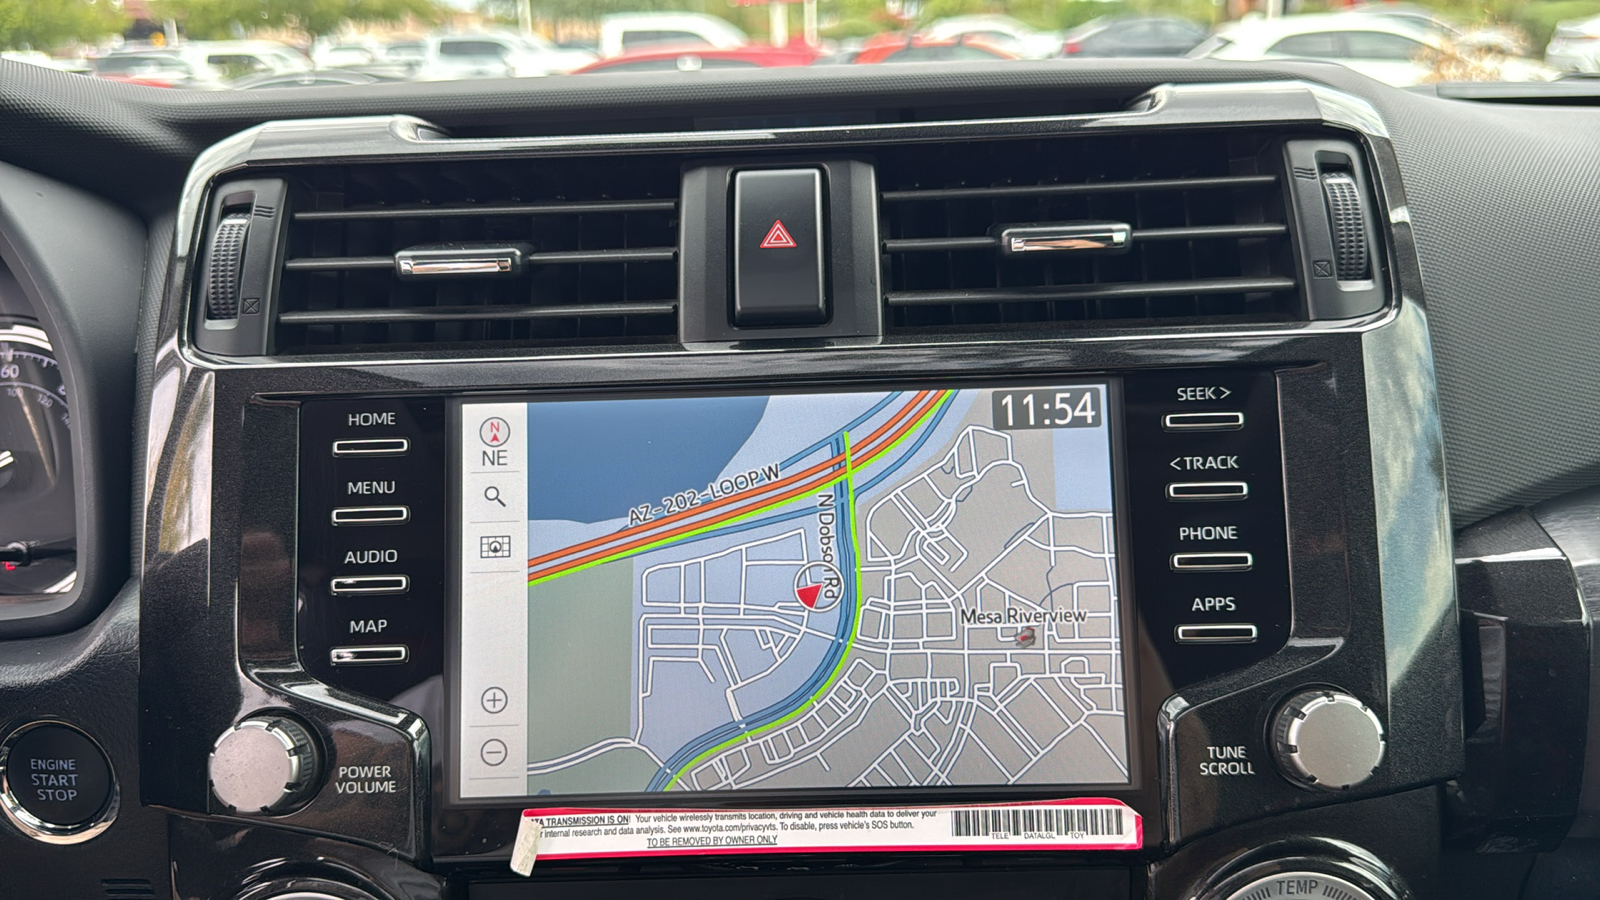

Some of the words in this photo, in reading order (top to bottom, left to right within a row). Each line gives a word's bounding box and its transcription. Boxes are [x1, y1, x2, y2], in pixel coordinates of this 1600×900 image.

[0, 364, 20, 379] 60
[1000, 393, 1097, 426] 11:54
[348, 412, 397, 426] HOME
[490, 421, 501, 433] N
[482, 450, 508, 466] NE
[347, 481, 397, 495] MENU
[628, 470, 759, 526] AZ-202-LOOP
[761, 463, 780, 482] W
[818, 494, 834, 508] N
[1179, 526, 1239, 541] PHONE
[818, 513, 836, 573] Dobson
[344, 550, 398, 565] AUDIO
[823, 577, 841, 600] Rd
[1191, 597, 1237, 612] APPS
[961, 608, 1002, 624] Mesa
[1006, 607, 1088, 624] Riverview
[349, 619, 388, 634] MAP
[1206, 746, 1246, 760] TUNE
[30, 758, 76, 772] ENGINE
[338, 765, 391, 779] POWER
[1199, 761, 1256, 776] SCROLL
[30, 774, 79, 788] START
[334, 780, 397, 795] VOLUME
[37, 788, 78, 803] STOP
[546, 816, 604, 827] TRANSMISSION
[607, 815, 615, 824] IS
[635, 814, 651, 823] Your
[653, 812, 677, 823] vehicle
[679, 813, 714, 823] wirelessly
[715, 812, 746, 821] transmits
[748, 812, 778, 821] location,
[779, 811, 803, 821] driving
[804, 811, 818, 819] and
[820, 811, 844, 819] vehicle
[846, 810, 868, 818] health
[869, 810, 886, 818] data
[887, 810, 895, 818] to
[896, 810, 919, 818] deliver
[921, 810, 937, 820] your
[544, 828, 571, 838] internal
[572, 827, 603, 837] research
[604, 827, 617, 836] and
[619, 827, 635, 835] data
[636, 825, 666, 836] analysis.
[667, 824, 682, 834] See
[779, 822, 789, 831] To
[790, 821, 818, 831] disable,
[819, 822, 839, 832] press
[840, 820, 870, 829] vehicle's
[872, 820, 888, 829] SOS
[890, 821, 914, 829] button.
[991, 832, 1009, 840] TELE
[1070, 831, 1085, 839] TOY
[647, 838, 658, 847] TO
[660, 838, 670, 846] BE
[672, 836, 711, 846] REMOVED
[713, 836, 724, 845] BY
[725, 835, 755, 844] OWNER
[757, 834, 778, 844] ONLY
[1276, 880, 1318, 895] TEMP
